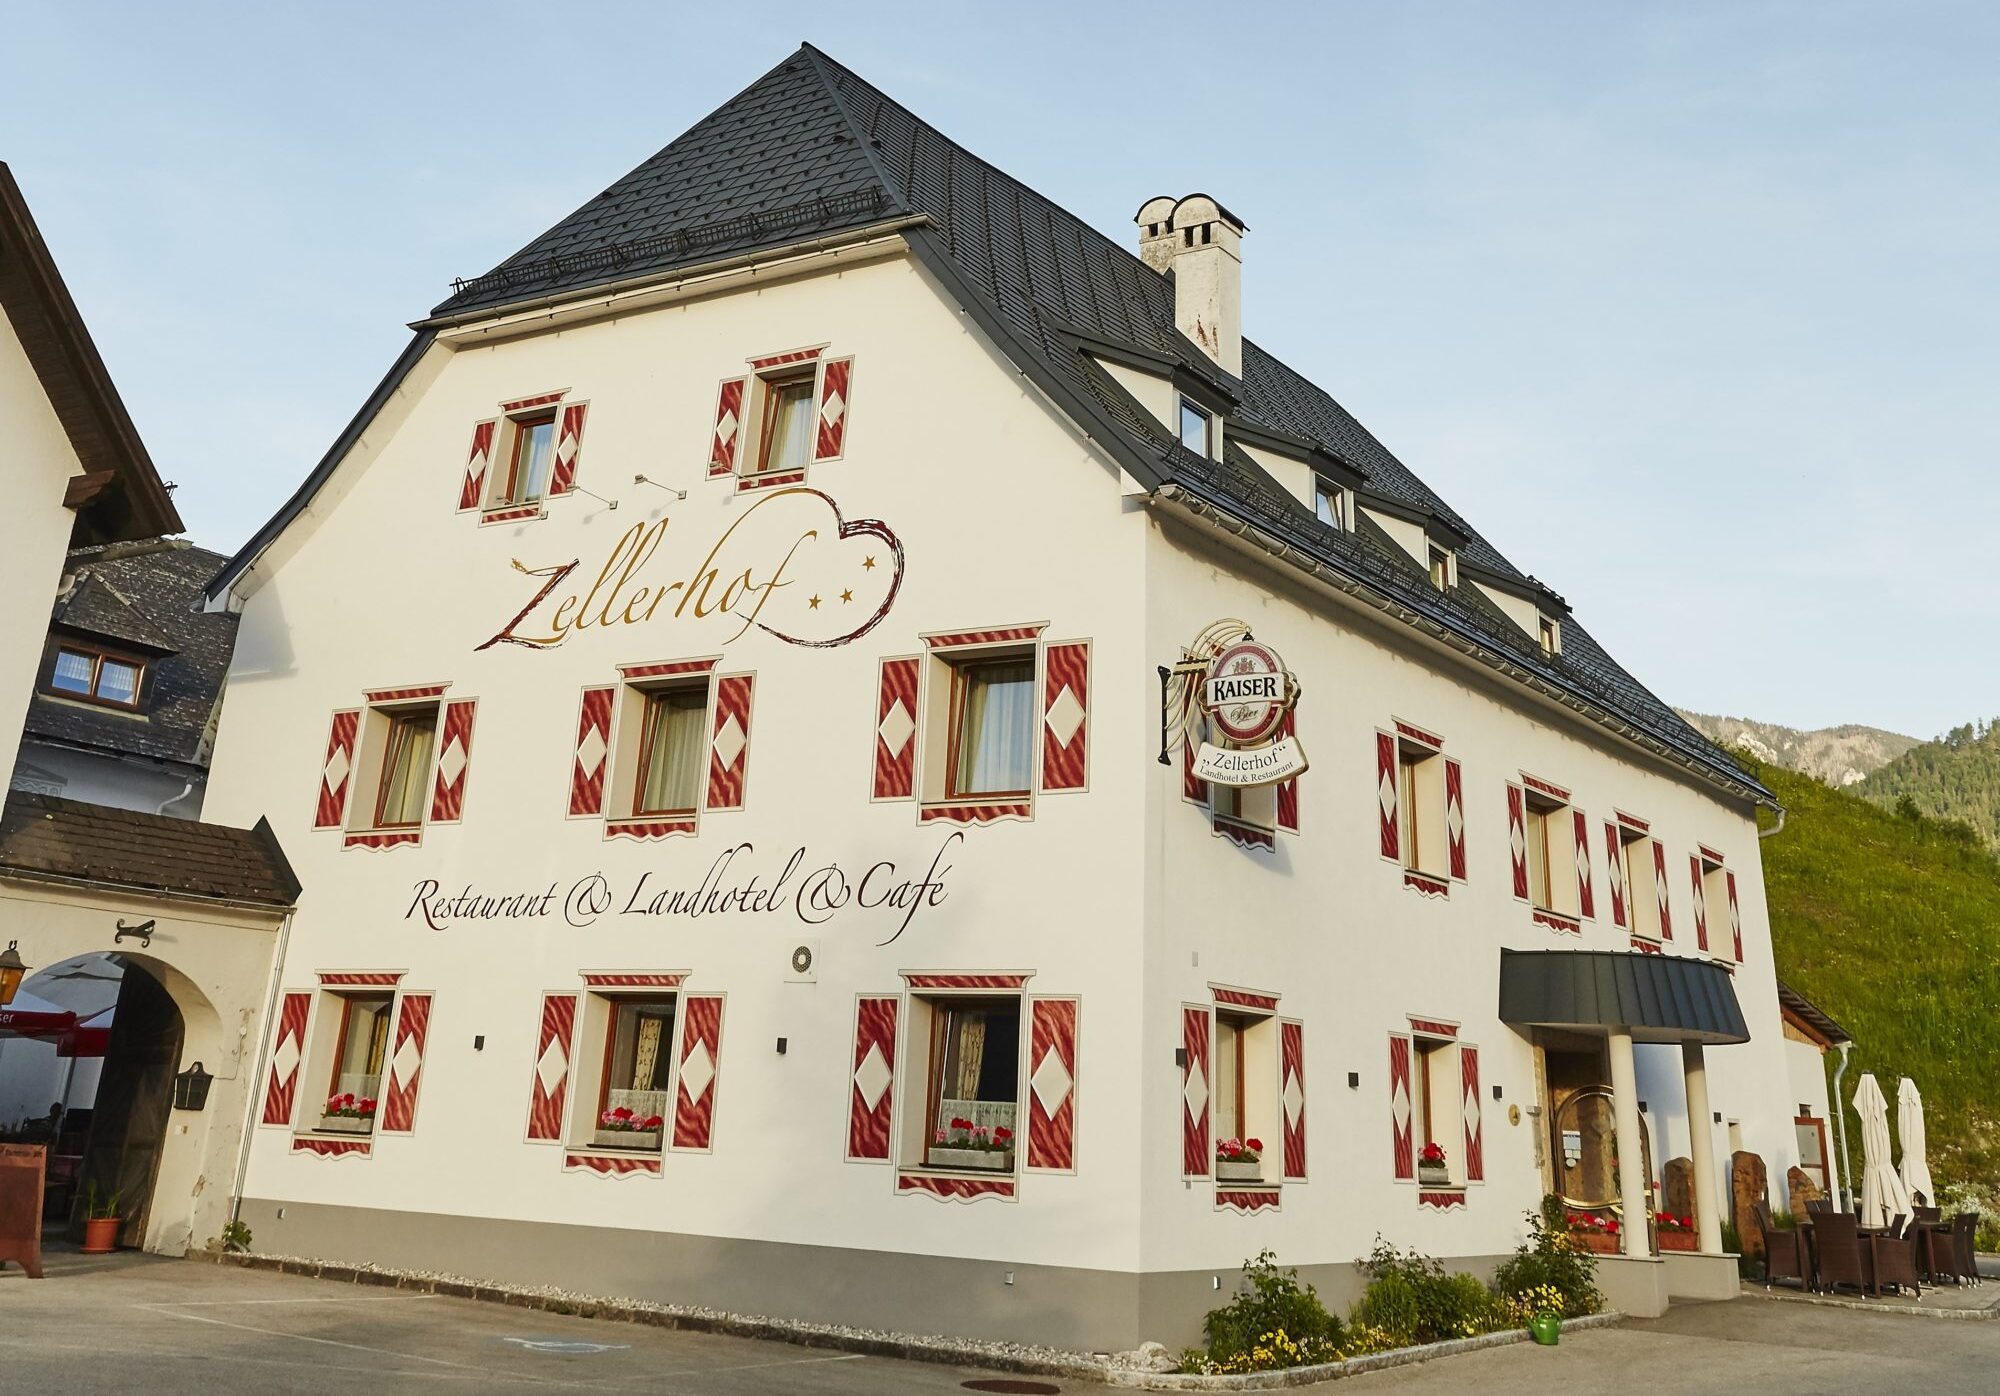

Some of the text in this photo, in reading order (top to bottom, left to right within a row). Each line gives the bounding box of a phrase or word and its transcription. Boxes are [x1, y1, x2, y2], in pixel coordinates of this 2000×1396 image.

[474, 489, 818, 651] Zellerhof
[1213, 676, 1278, 702] KAISER
[1230, 706, 1259, 724] Bier
[1199, 761, 1294, 782] Landhotel & Restaurant
[405, 832, 965, 947] Restaurant & Landhotel & Café
